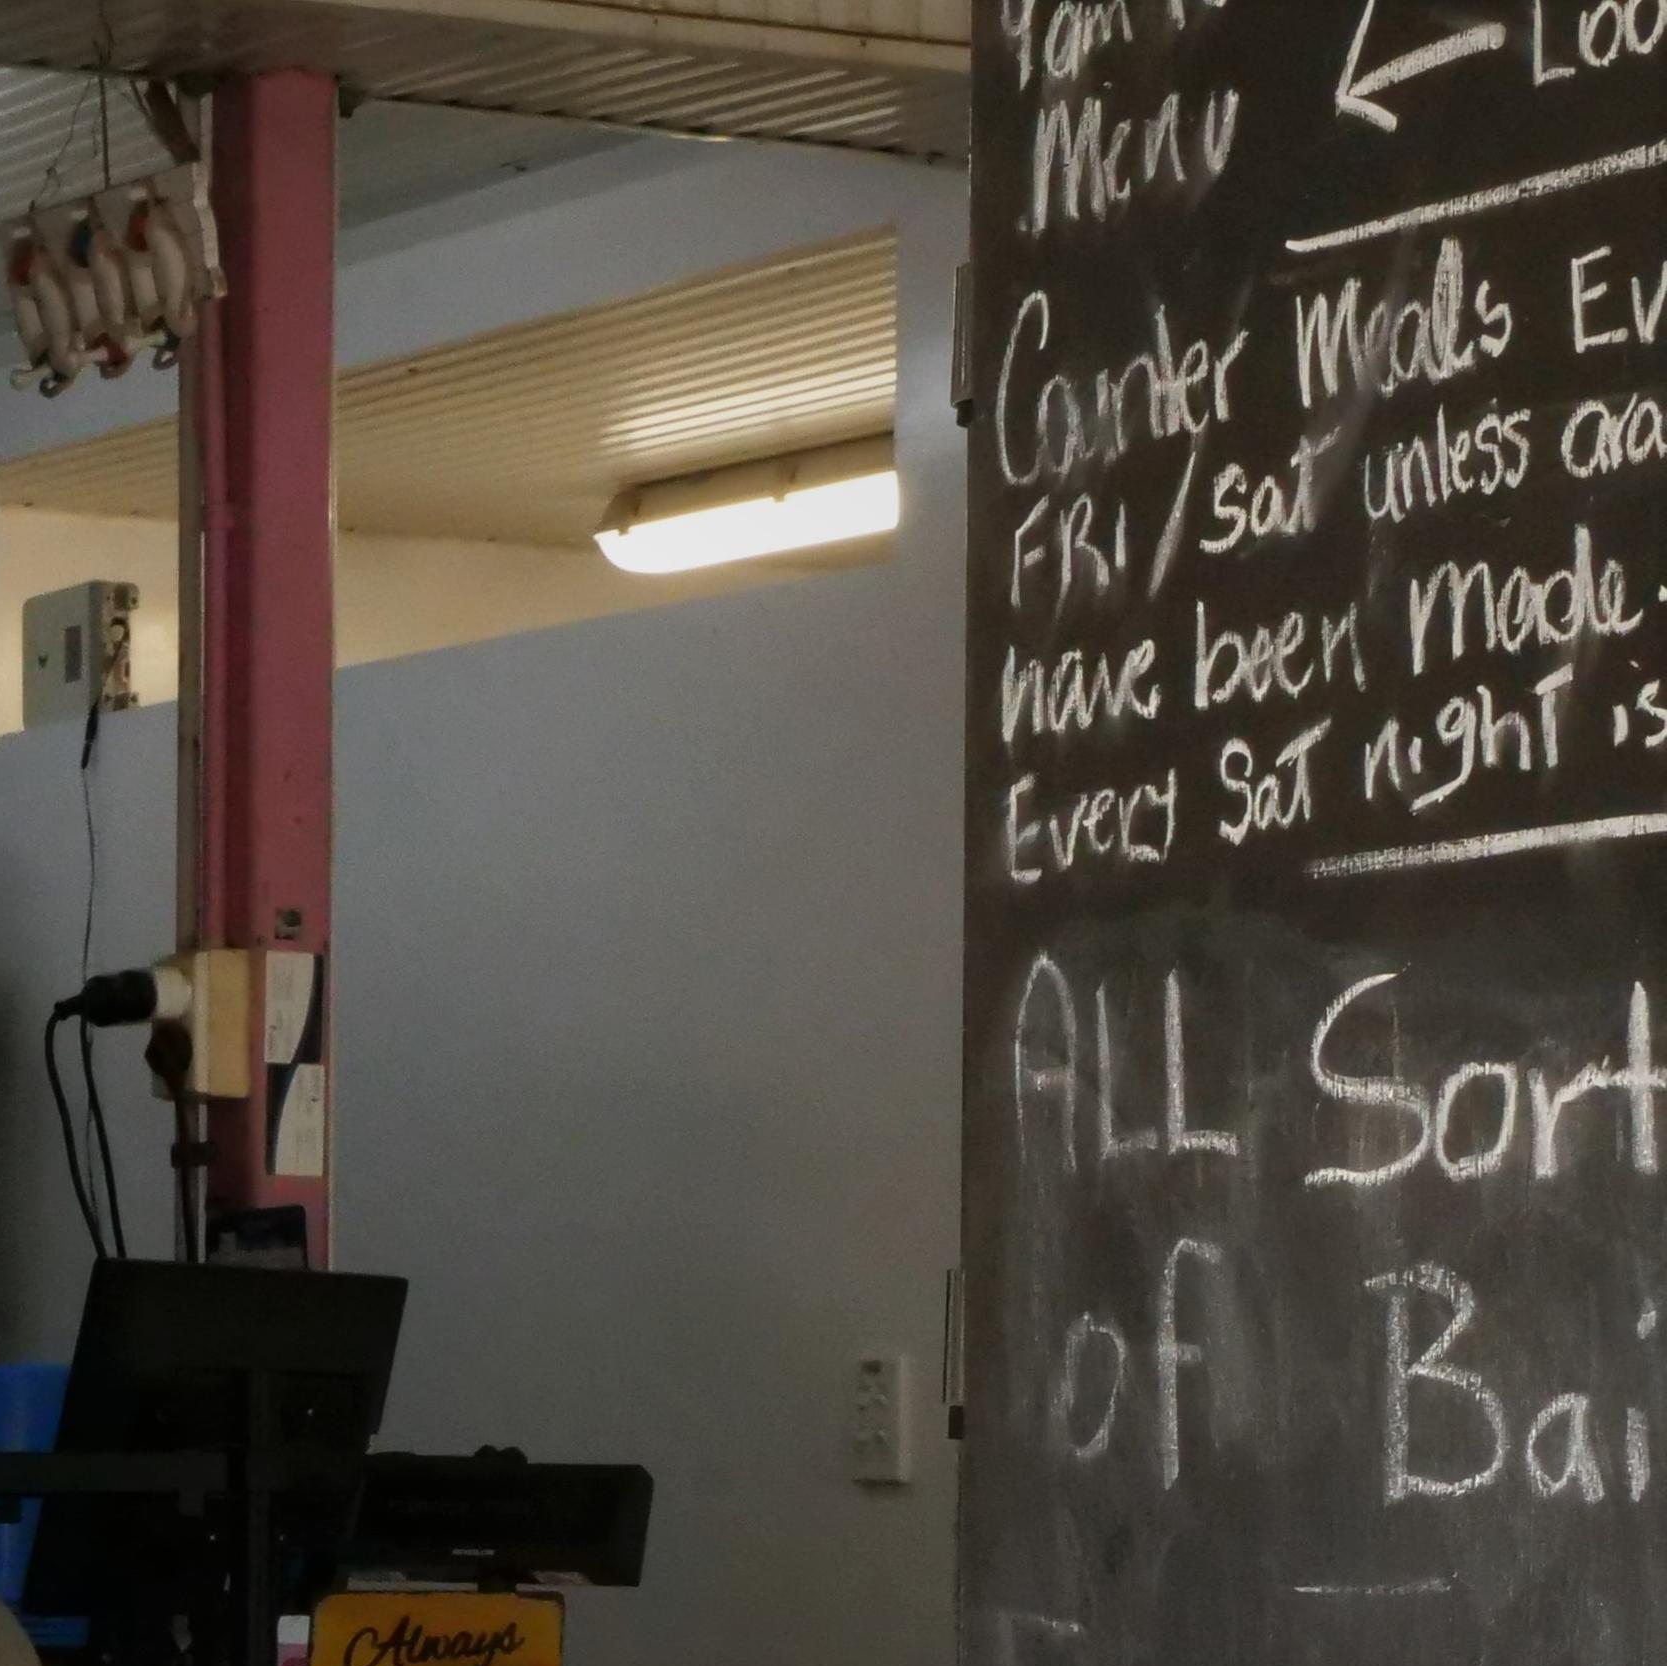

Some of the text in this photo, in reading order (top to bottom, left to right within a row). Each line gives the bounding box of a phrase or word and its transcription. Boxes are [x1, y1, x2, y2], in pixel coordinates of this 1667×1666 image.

[1364, 402, 1532, 523] unless
[1194, 598, 1367, 712] been
[1005, 768, 1178, 884] Every
[1013, 950, 1240, 1172] ALL
[1361, 1259, 1657, 1508] Bai
